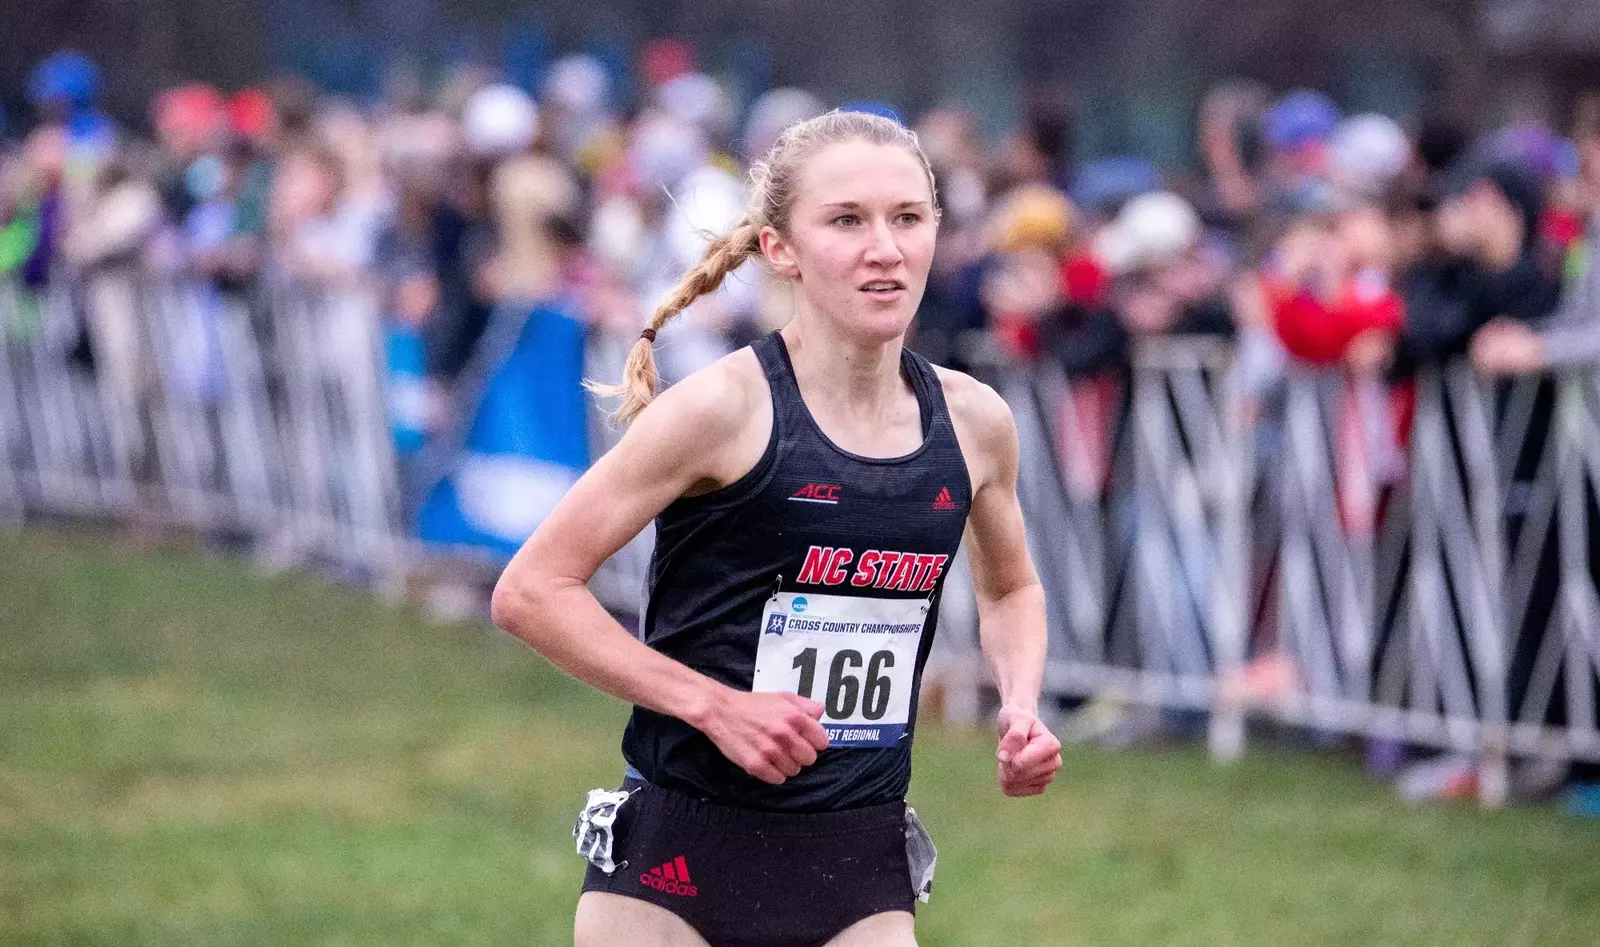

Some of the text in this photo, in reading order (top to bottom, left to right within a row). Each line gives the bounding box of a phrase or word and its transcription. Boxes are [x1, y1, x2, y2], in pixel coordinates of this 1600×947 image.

[793, 482, 841, 500] ACC
[796, 545, 949, 592] NC STATE
[788, 618, 921, 634] CROSS COUNTRY CHAMPIONSHIPS
[792, 647, 895, 721] 166
[842, 729, 881, 741] REGIONAL
[640, 873, 698, 897] adidas
